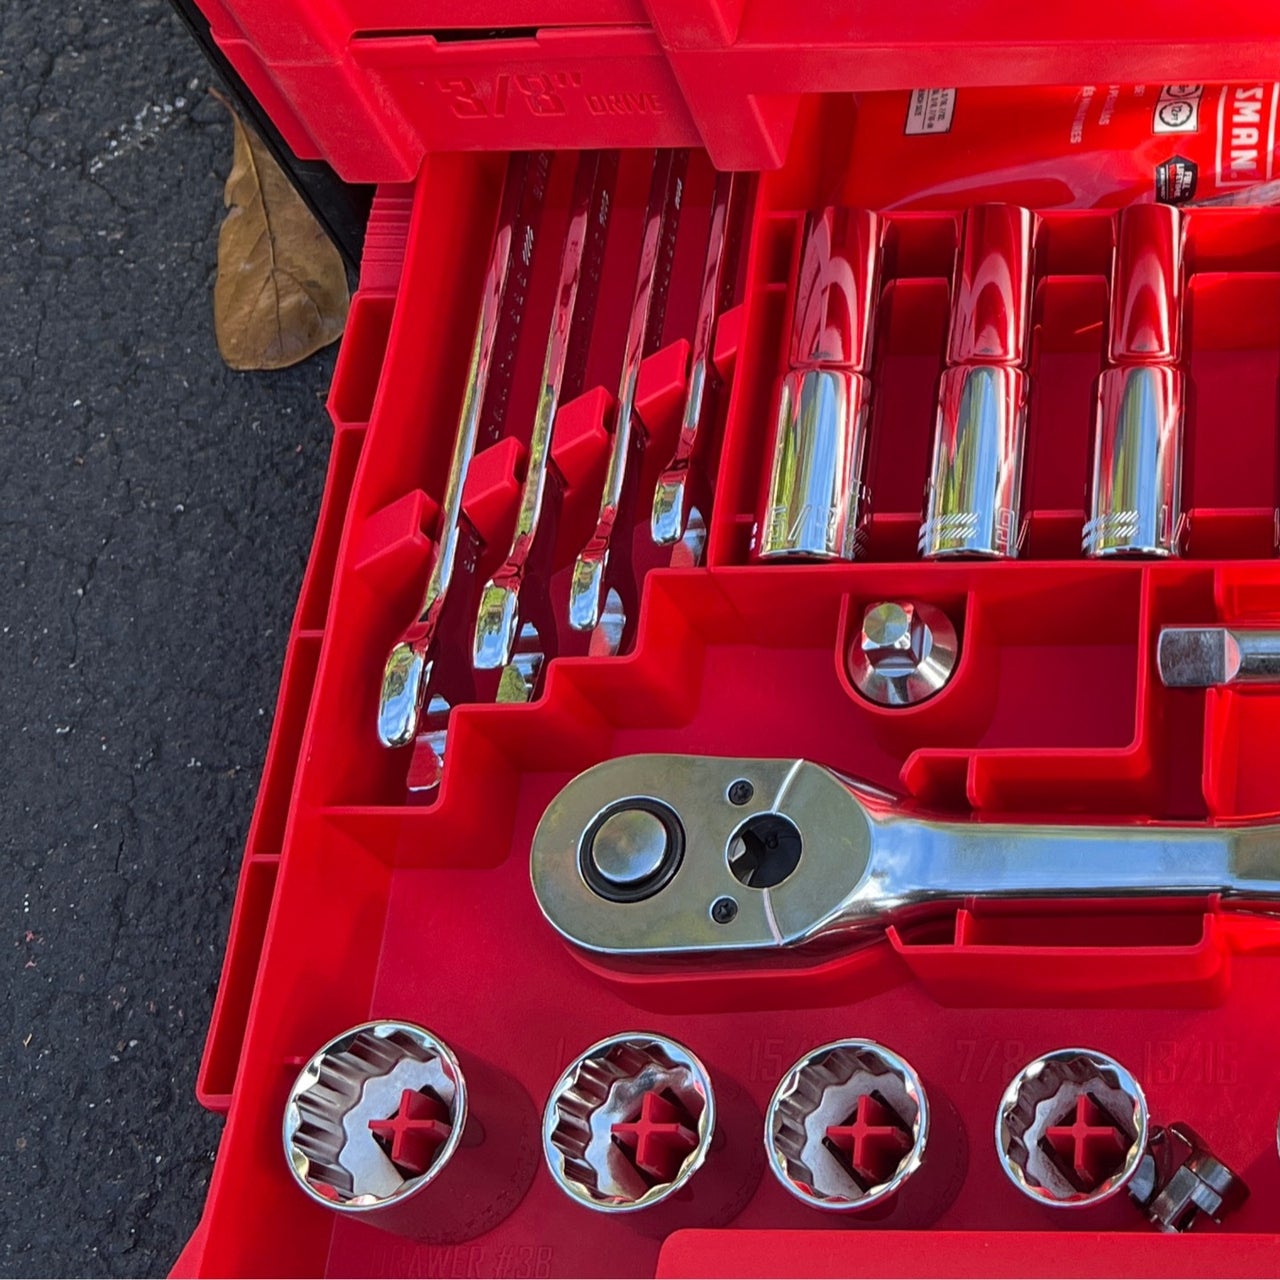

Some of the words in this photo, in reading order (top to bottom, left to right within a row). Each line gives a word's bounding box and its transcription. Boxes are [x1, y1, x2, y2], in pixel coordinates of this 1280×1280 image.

[439, 72, 583, 119] 3/8"
[585, 92, 664, 116] DRIVE
[1231, 85, 1264, 170] SMAN
